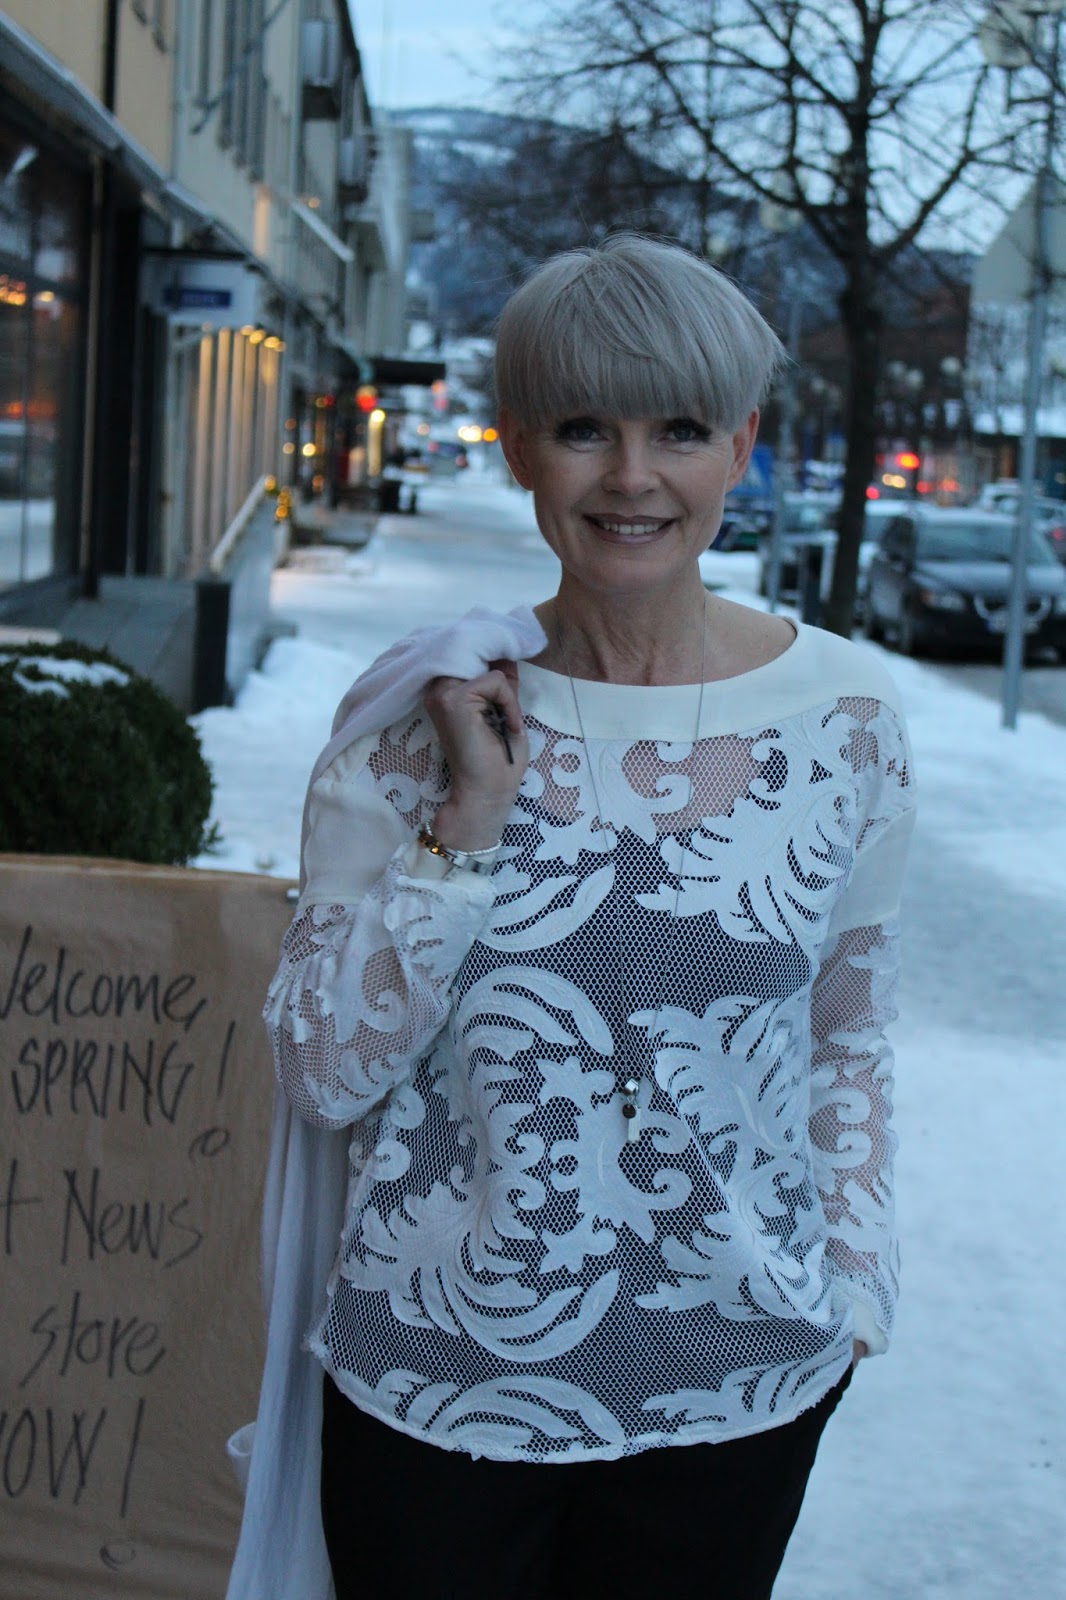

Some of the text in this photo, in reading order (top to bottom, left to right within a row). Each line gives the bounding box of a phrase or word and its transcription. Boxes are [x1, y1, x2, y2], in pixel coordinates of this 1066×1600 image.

[61, 1167, 203, 1269] News
[18, 1291, 166, 1387] store
[0, 1398, 146, 1571] OW!
